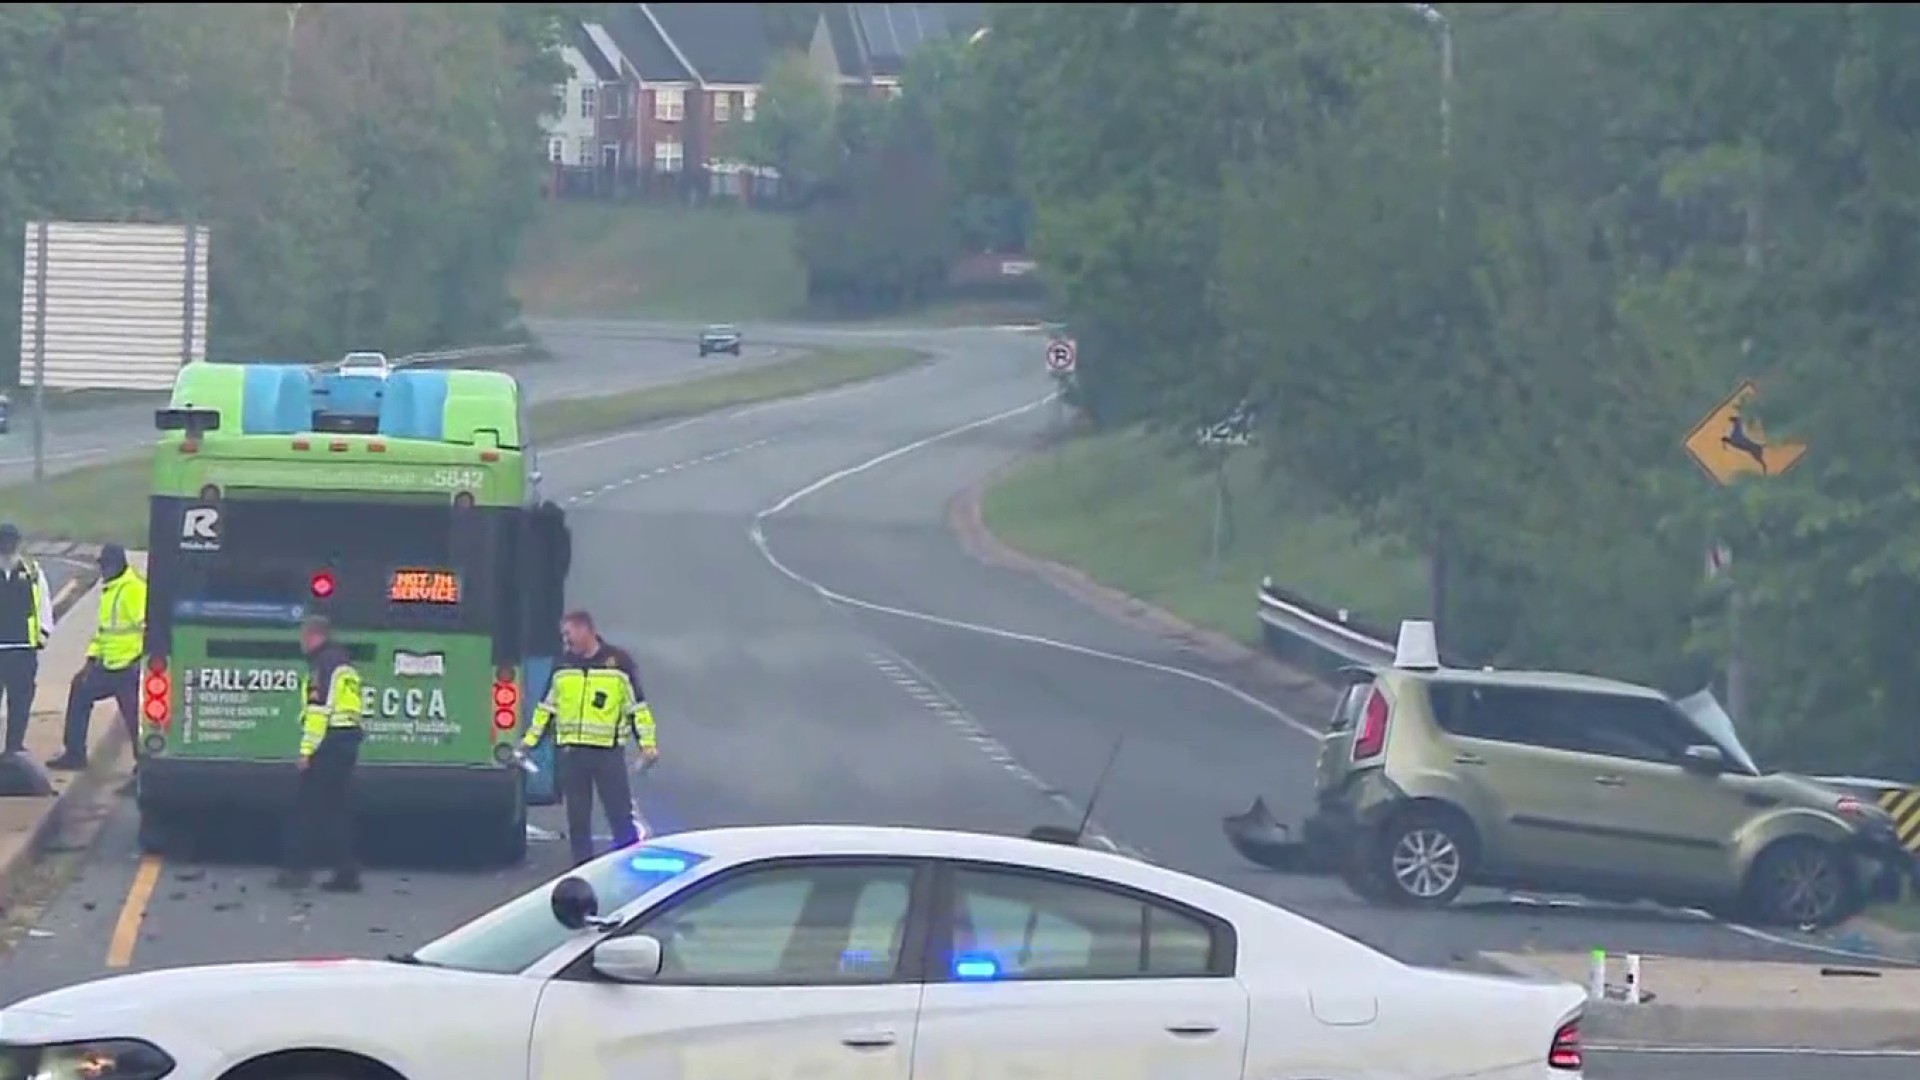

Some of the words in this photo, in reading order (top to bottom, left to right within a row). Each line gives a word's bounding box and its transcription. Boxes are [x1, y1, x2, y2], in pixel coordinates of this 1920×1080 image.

[434, 469, 483, 489] 5842
[183, 508, 219, 538] R
[397, 573, 428, 587] NOT
[392, 587, 457, 602] SERVICE
[200, 668, 245, 691] FALL
[247, 669, 298, 691] 2026
